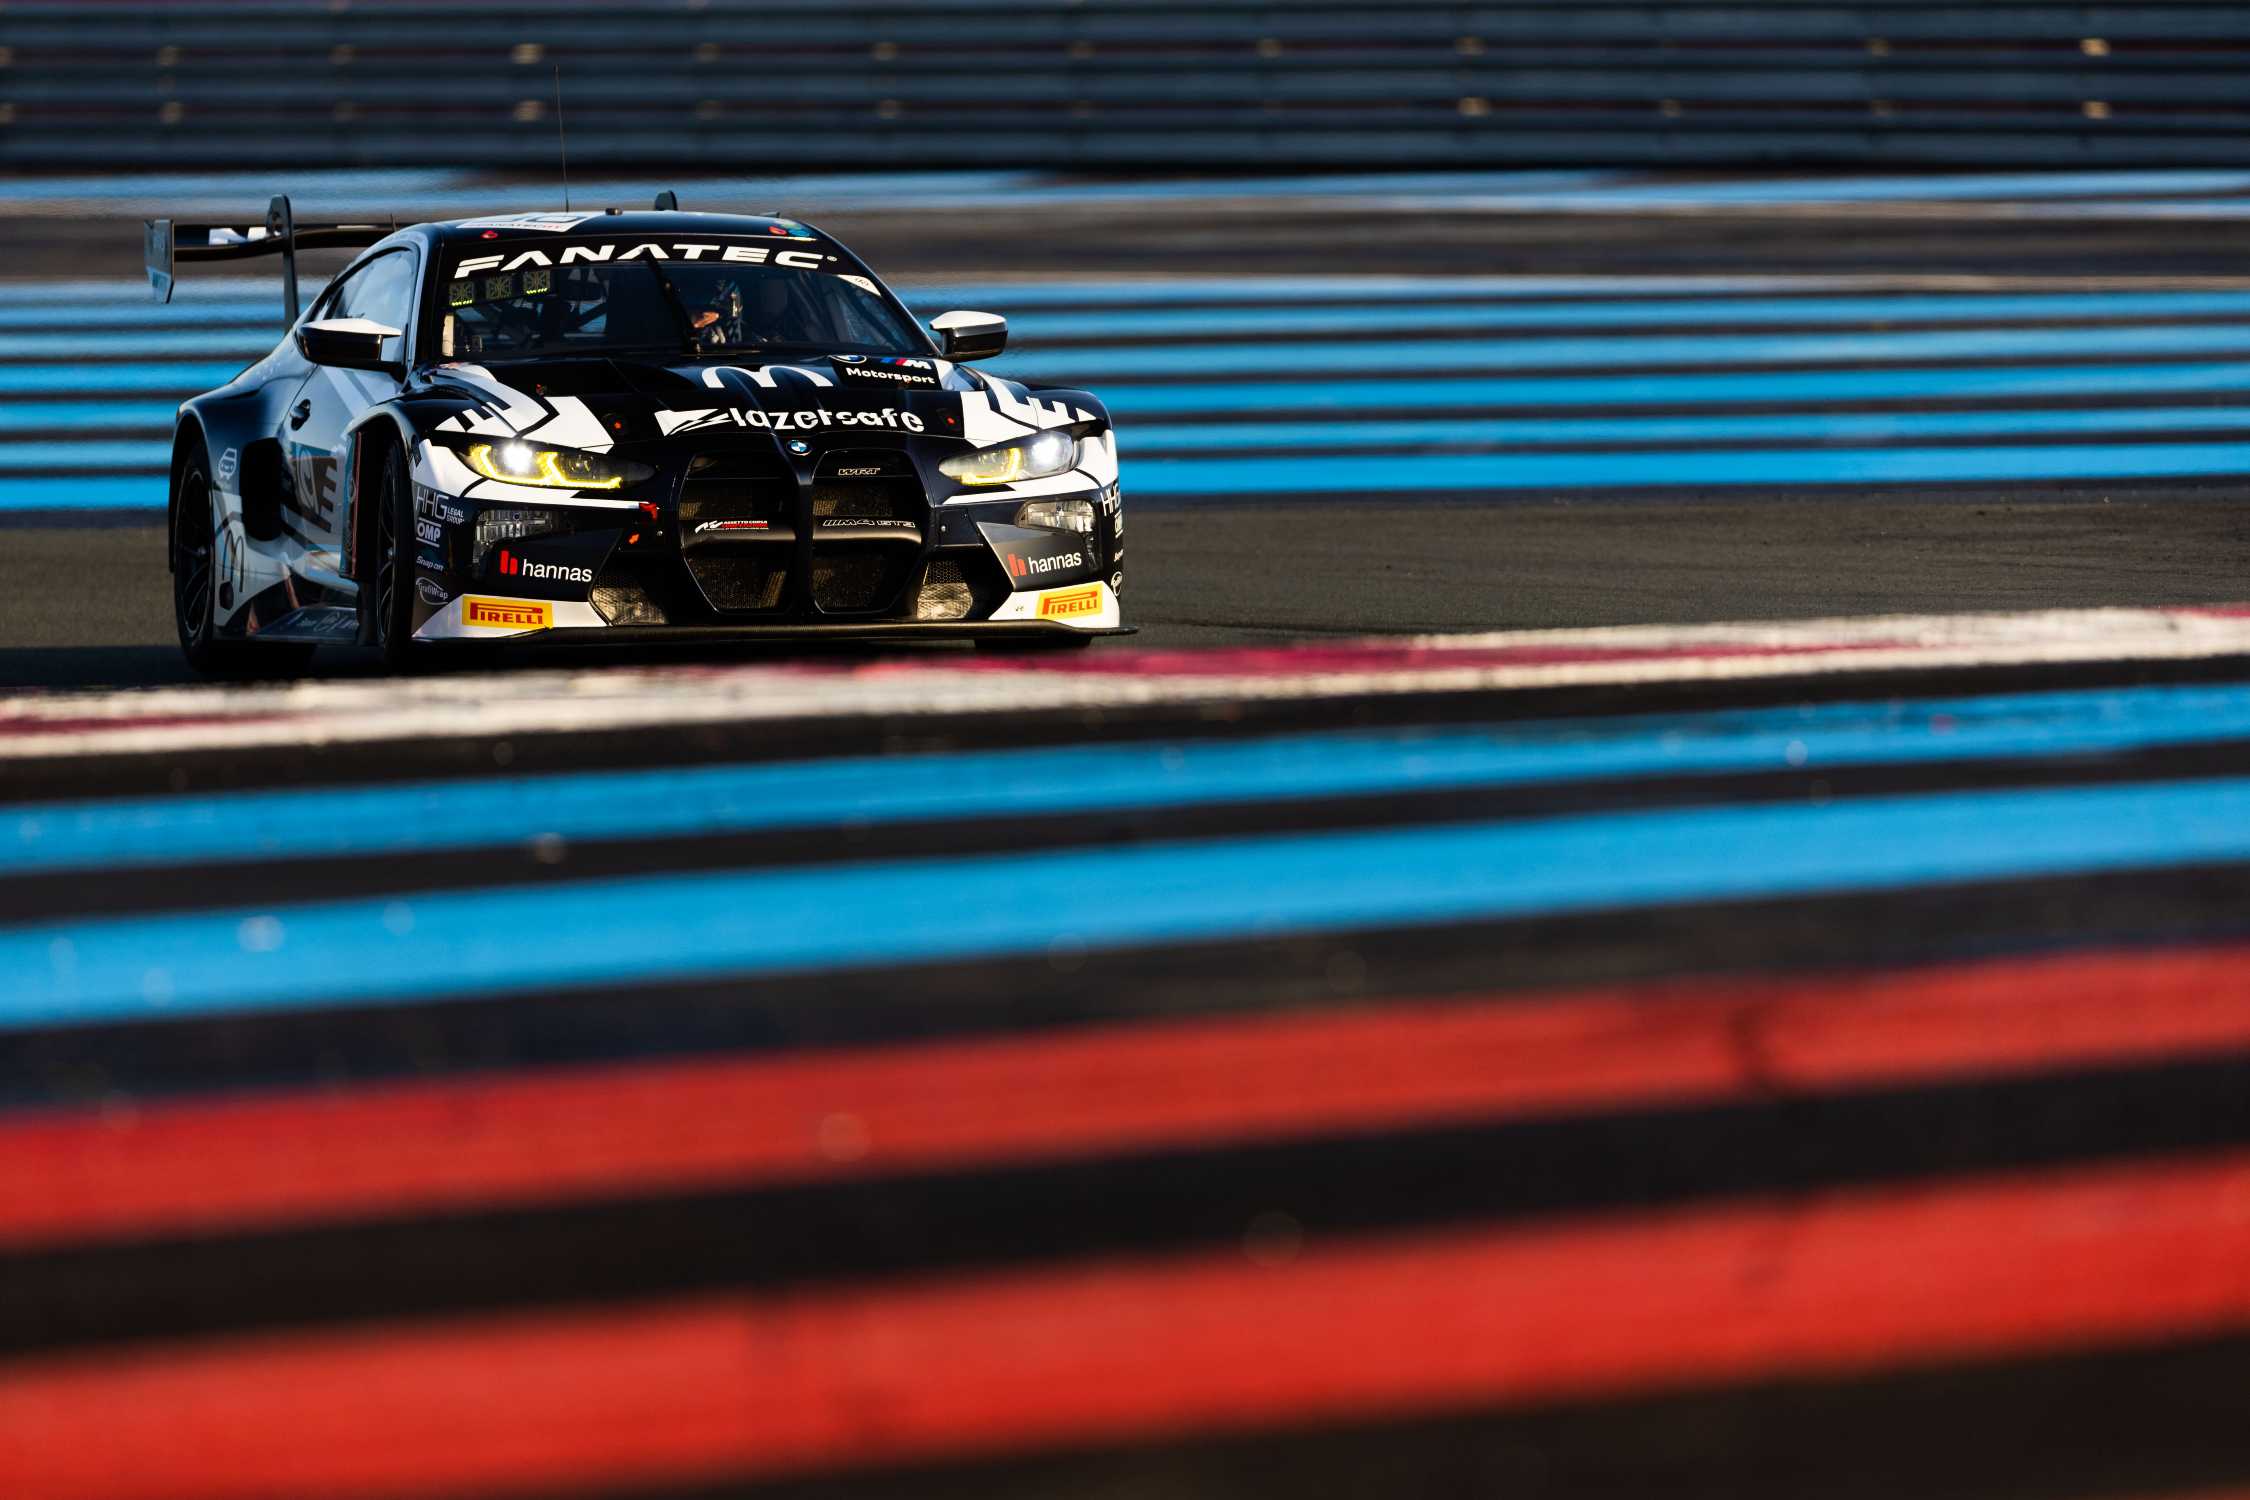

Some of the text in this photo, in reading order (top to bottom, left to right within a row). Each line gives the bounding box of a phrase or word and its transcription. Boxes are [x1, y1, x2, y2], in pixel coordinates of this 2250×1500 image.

[454, 243, 825, 279] FANATEC
[845, 367, 936, 384] Motorsport
[729, 407, 925, 432] lazersafe
[447, 507, 464, 518] LEGAL
[416, 522, 441, 543] OMP
[522, 558, 593, 582] hannas
[1028, 552, 1082, 574] hannas
[469, 601, 544, 625] PIRELLI
[1042, 590, 1098, 615] PIRELLI
